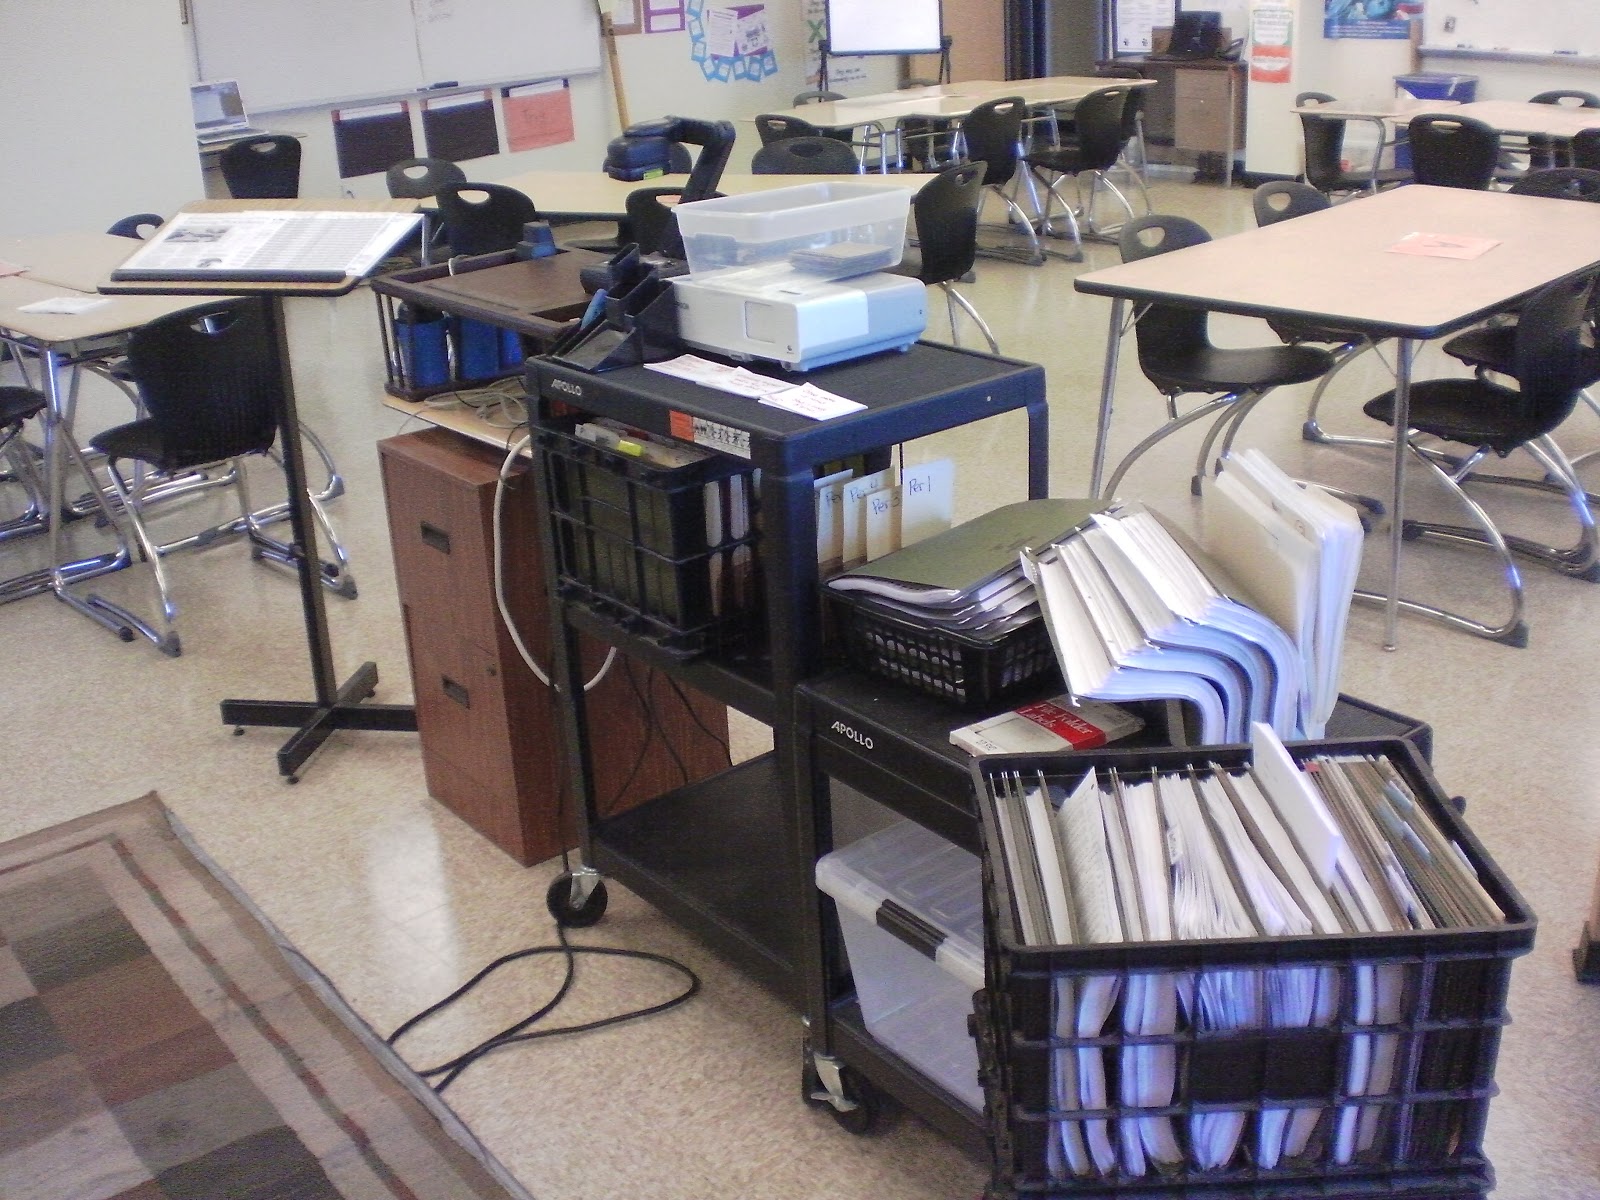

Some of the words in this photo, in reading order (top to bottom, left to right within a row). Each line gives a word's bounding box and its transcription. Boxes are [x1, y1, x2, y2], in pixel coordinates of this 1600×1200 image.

[551, 379, 583, 396] APOLLO
[909, 478, 926, 496] Per
[872, 498, 889, 515] Per
[1019, 708, 1058, 728] Labels
[1055, 713, 1094, 735] Folder
[831, 720, 874, 750] APOLLO
